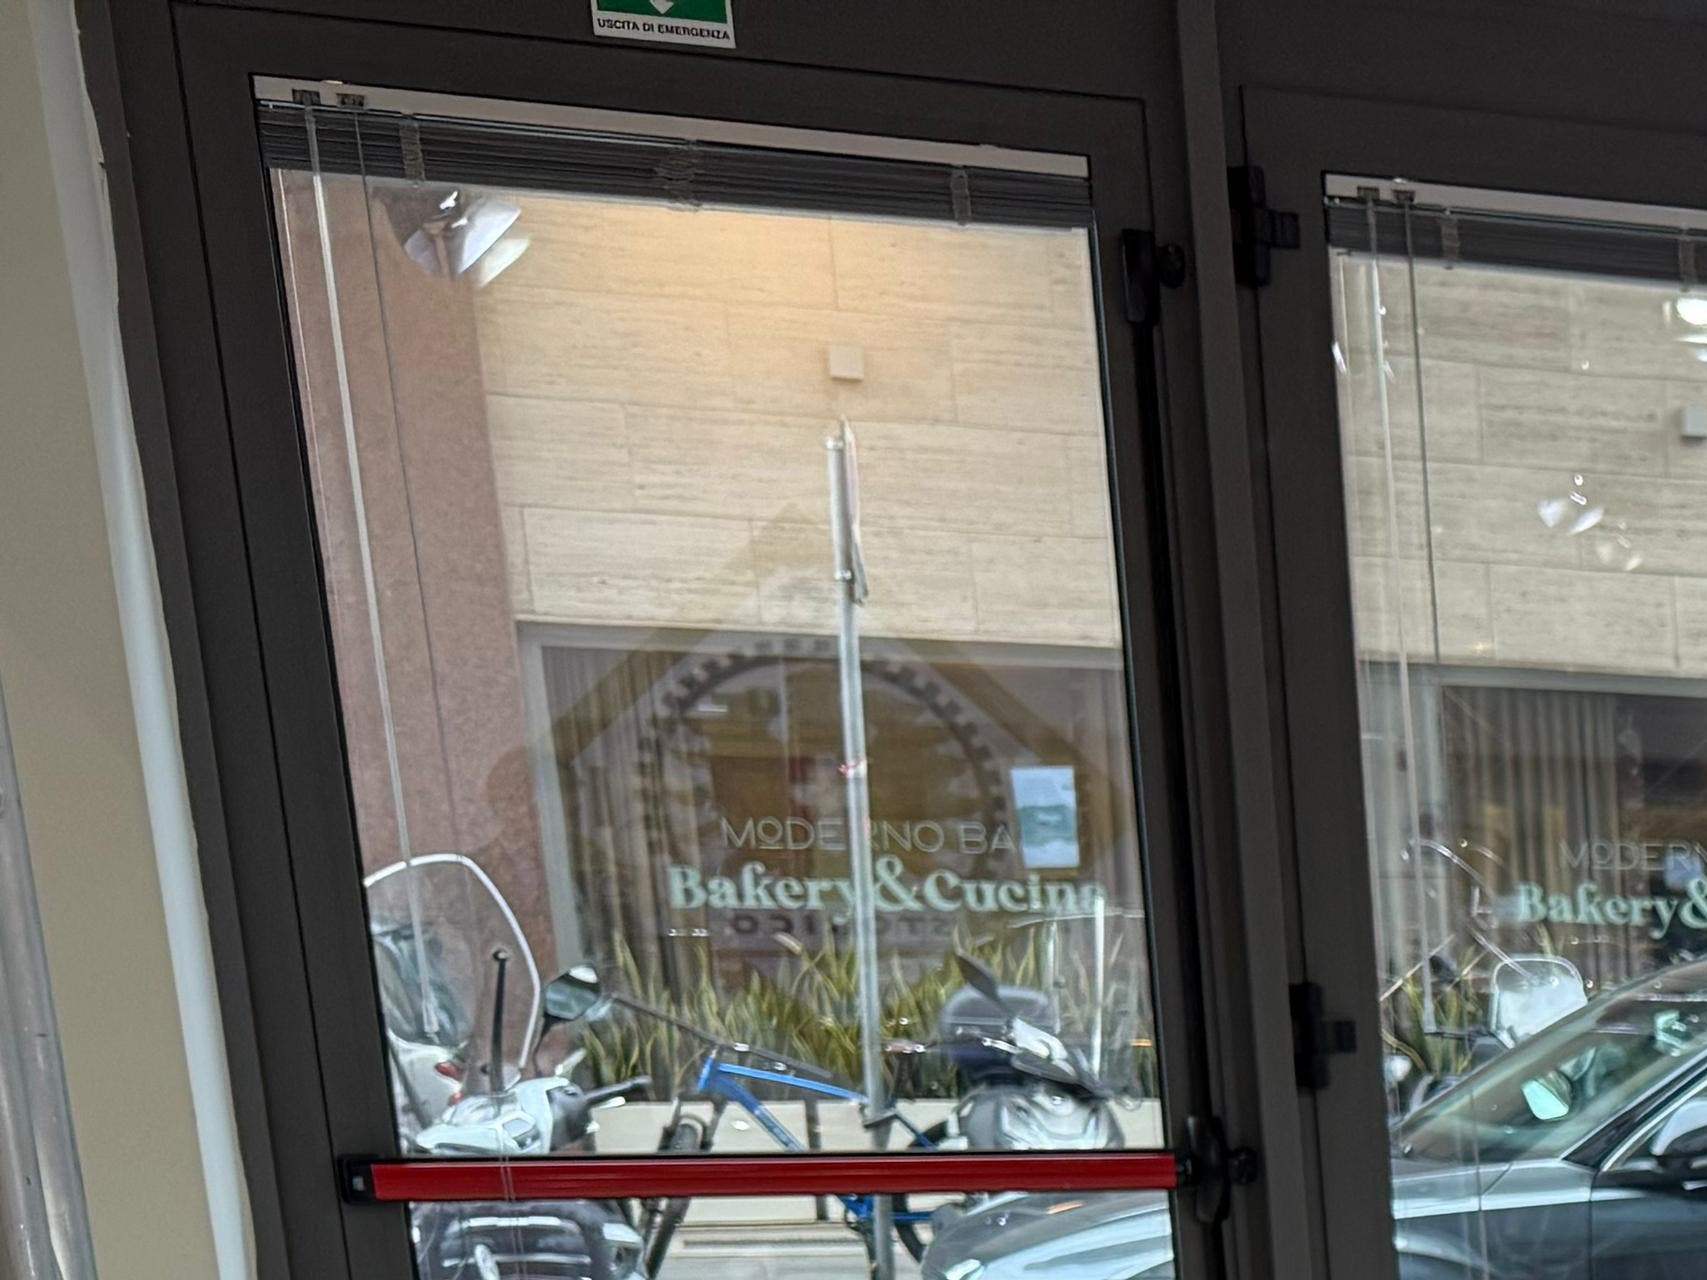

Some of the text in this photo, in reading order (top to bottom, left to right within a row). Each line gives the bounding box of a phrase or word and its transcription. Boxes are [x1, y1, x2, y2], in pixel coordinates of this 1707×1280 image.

[596, 17, 731, 40] USCITA DI EMERGENZA
[958, 820, 1018, 855] BA
